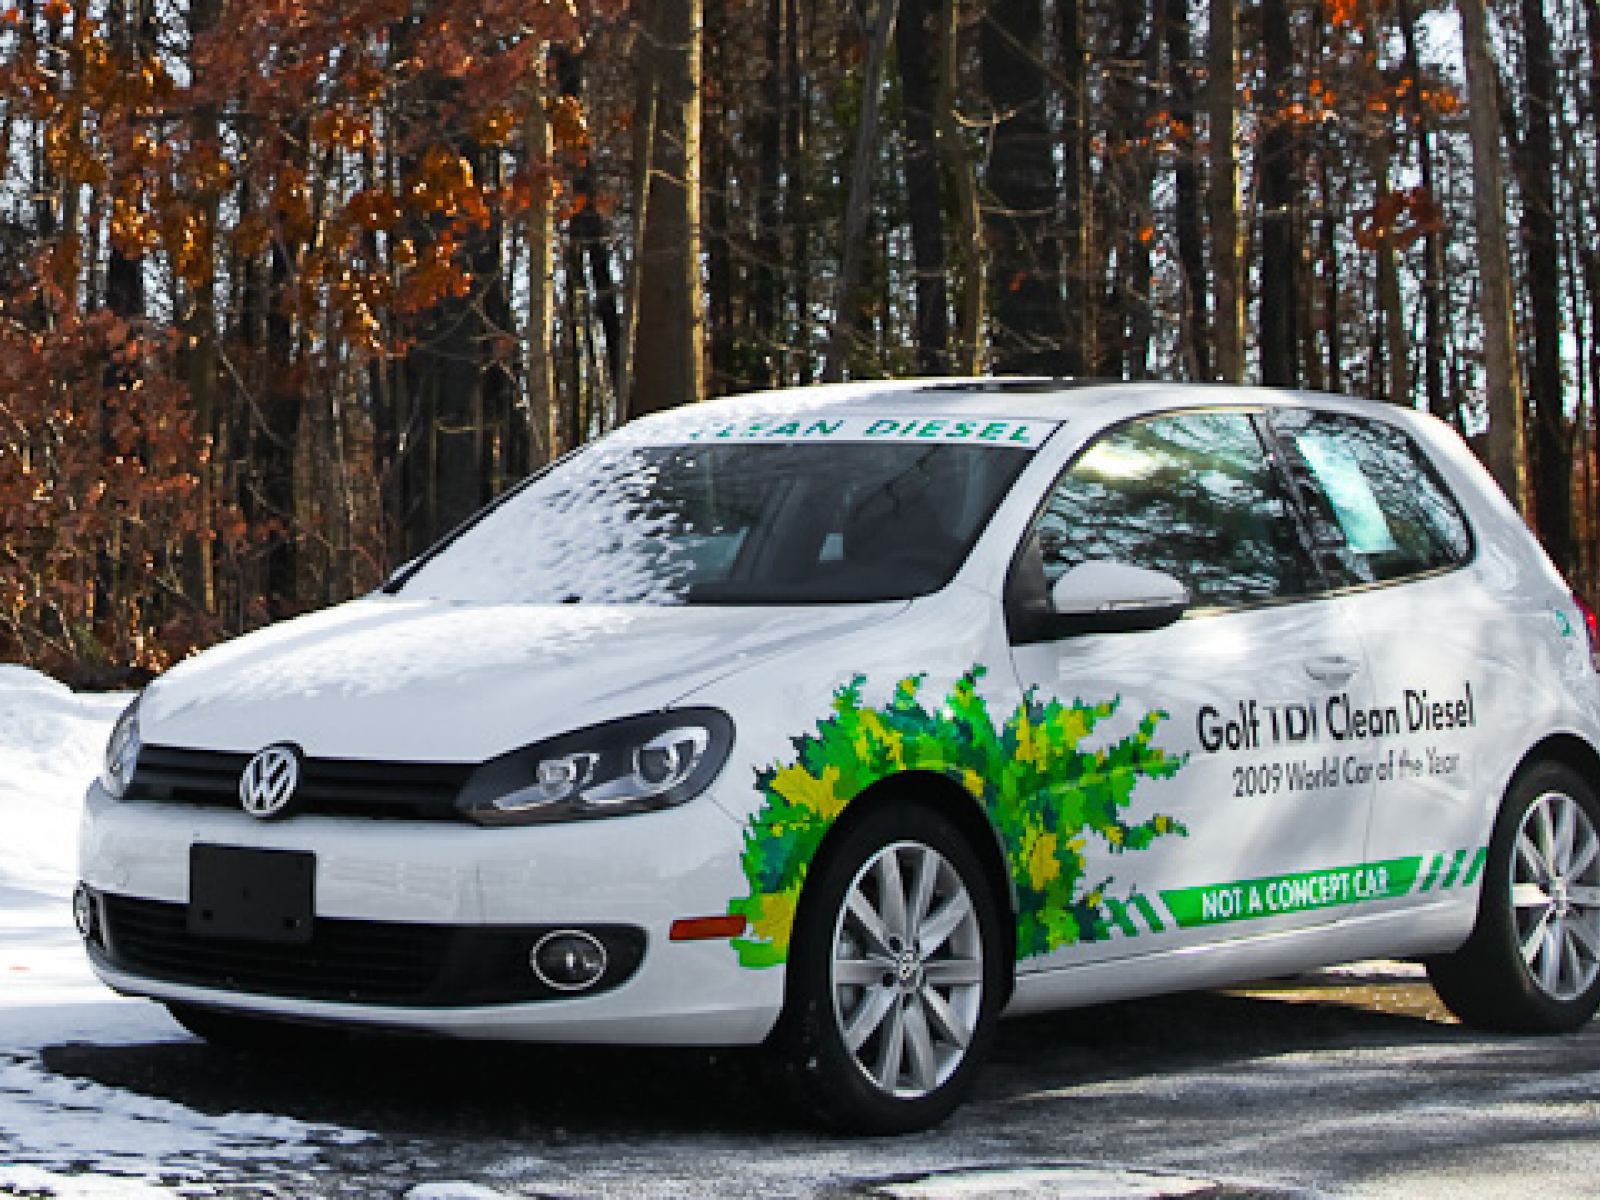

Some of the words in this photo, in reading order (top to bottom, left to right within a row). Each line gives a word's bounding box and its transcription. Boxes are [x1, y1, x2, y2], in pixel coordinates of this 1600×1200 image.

[689, 419, 846, 440] LEAN
[864, 419, 1030, 444] DIESEL
[1196, 700, 1260, 753] Golf
[1263, 700, 1319, 742] TDI
[1326, 692, 1400, 741] Clean
[1403, 680, 1476, 733] Diesel
[1232, 763, 1283, 798] 2009
[1285, 756, 1340, 791] World
[1343, 756, 1374, 784] Car
[1376, 749, 1393, 781] of
[1399, 747, 1424, 777] the
[1426, 747, 1460, 774] Year
[1202, 886, 1243, 920] NOT
[1248, 885, 1264, 914] A
[1265, 872, 1350, 911] CONCEPT
[1355, 866, 1390, 898] CAR
